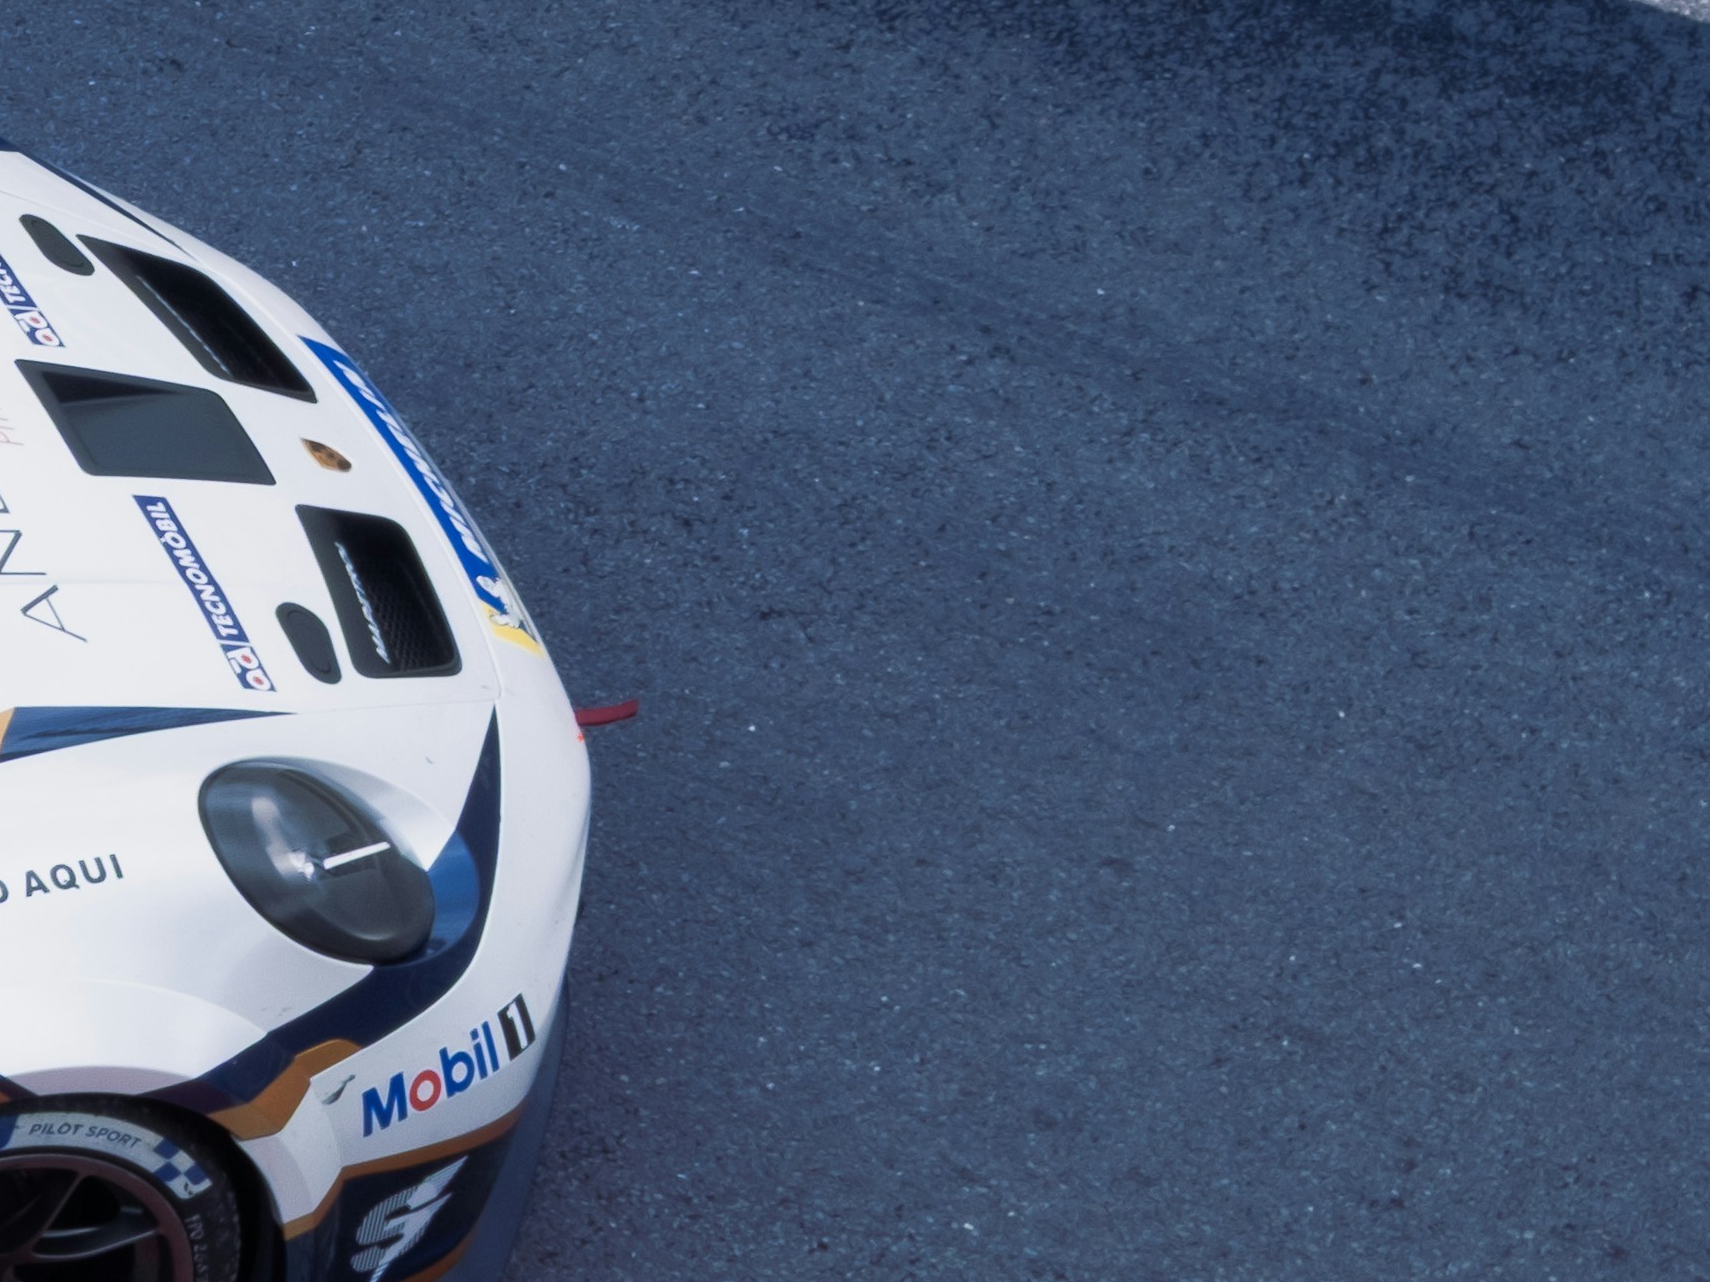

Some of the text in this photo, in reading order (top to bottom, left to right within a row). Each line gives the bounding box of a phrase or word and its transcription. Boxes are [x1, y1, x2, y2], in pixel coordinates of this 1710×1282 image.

[23, 852, 126, 898] AQUI
[361, 1020, 500, 1138] Mobil
[28, 1122, 142, 1150] PILOT SPORT
